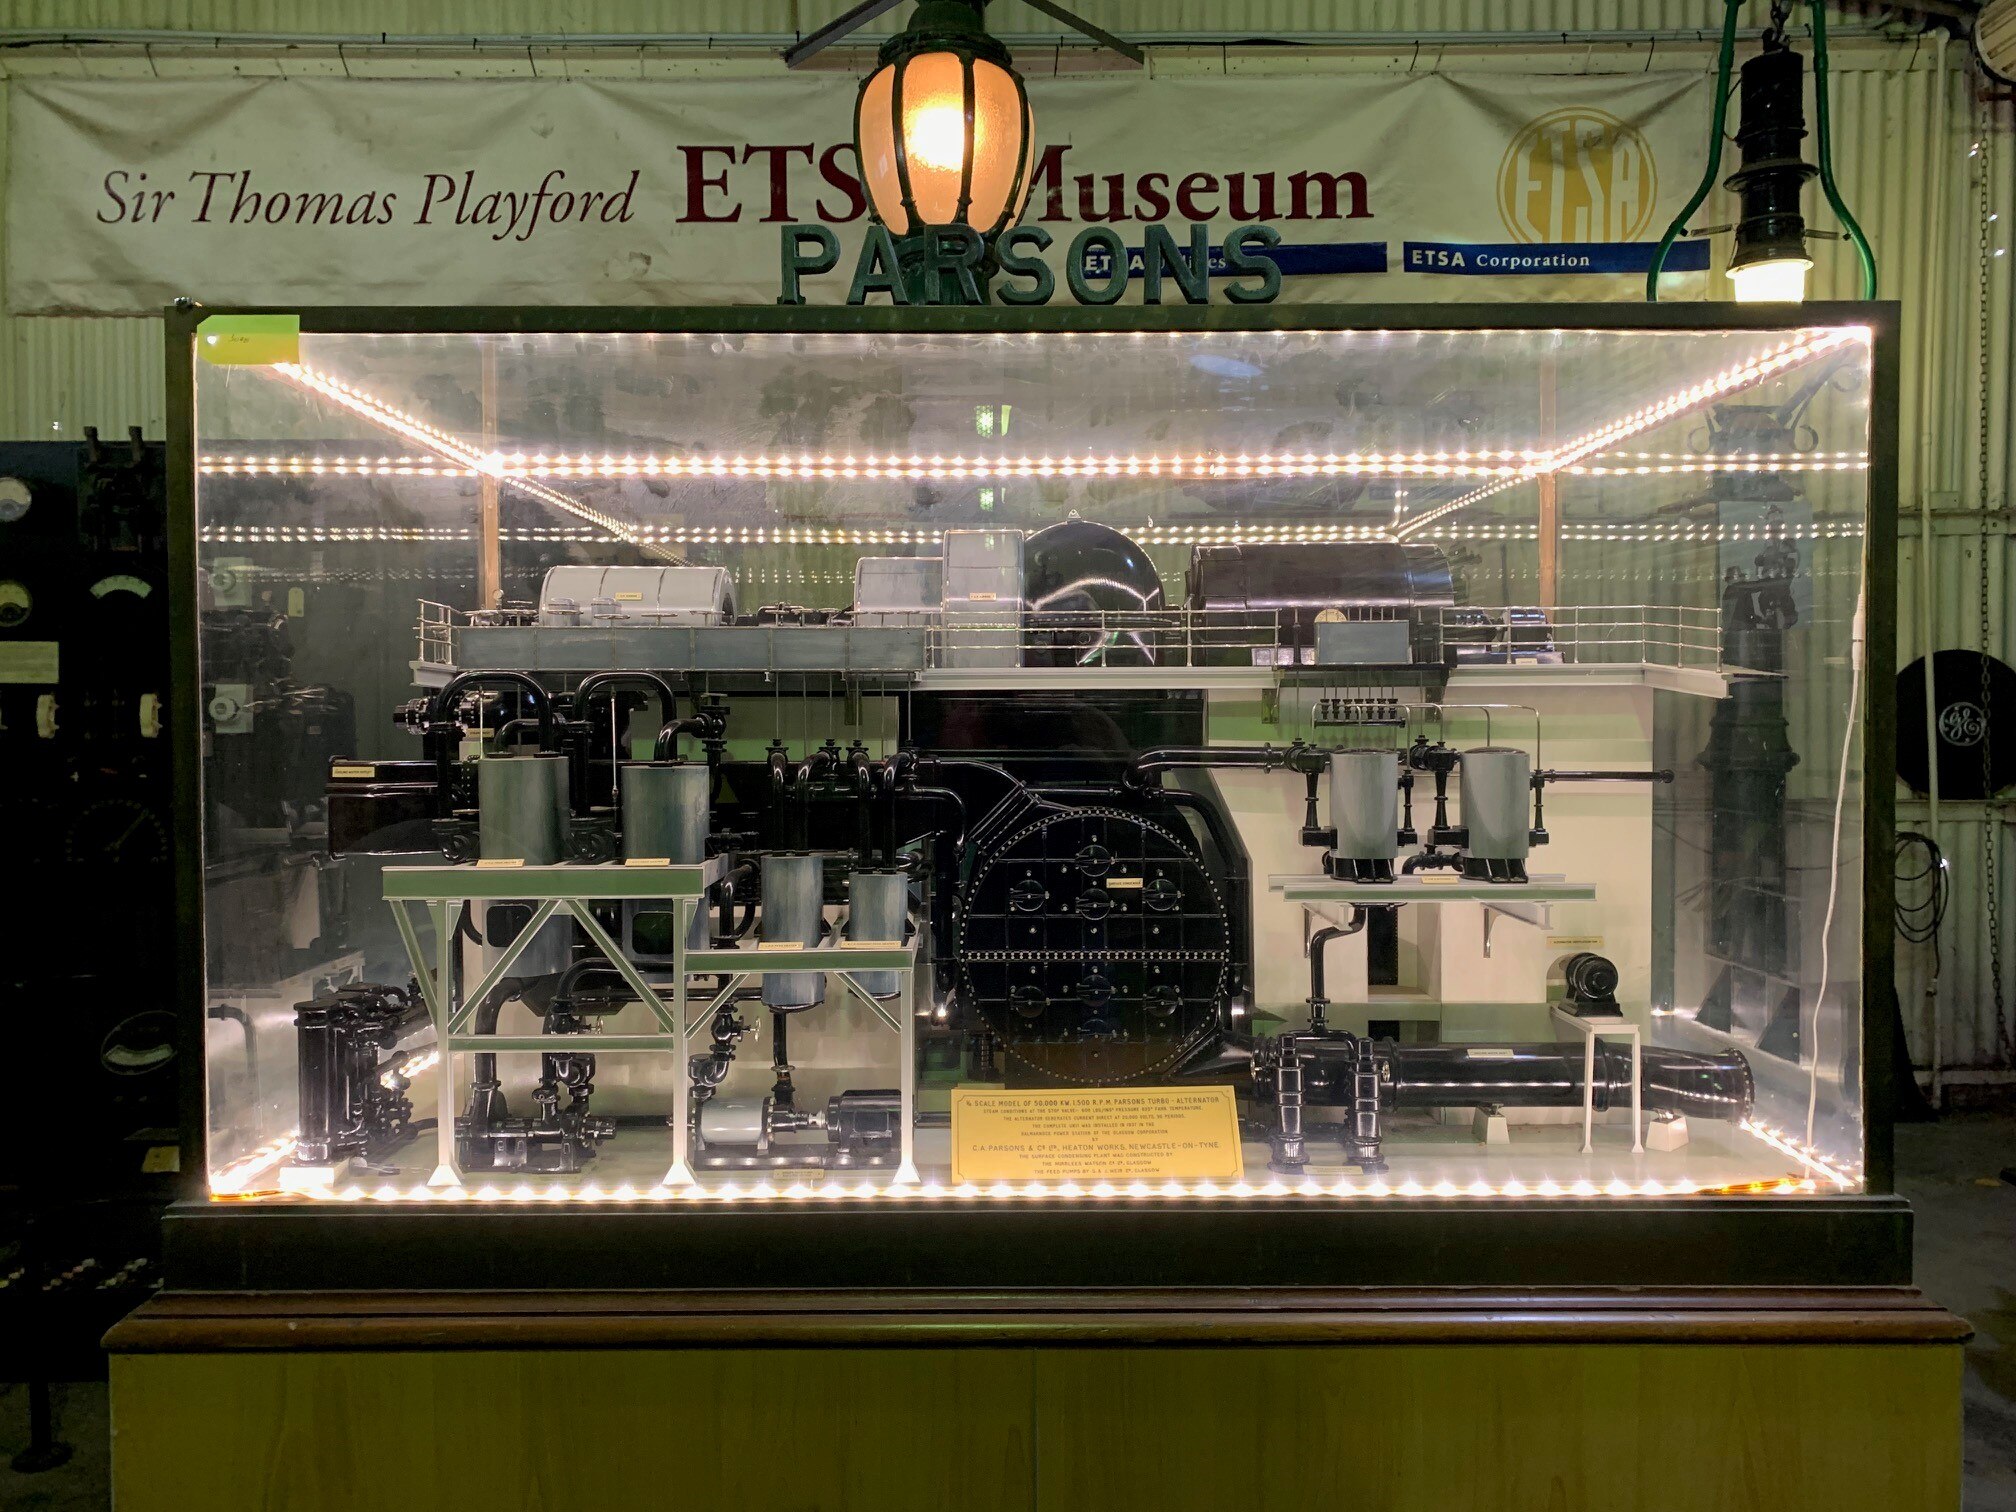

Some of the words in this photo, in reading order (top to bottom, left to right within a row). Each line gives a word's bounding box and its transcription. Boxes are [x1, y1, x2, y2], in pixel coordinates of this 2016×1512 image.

[96, 170, 175, 224] Sir
[188, 170, 398, 225] Thomas
[413, 169, 642, 242] Playford
[676, 143, 867, 223] ETS
[776, 223, 1282, 306] PARSONS
[1085, 254, 1145, 272] ETA
[1411, 249, 1466, 267] ETSA
[1476, 252, 1591, 269] Corporation
